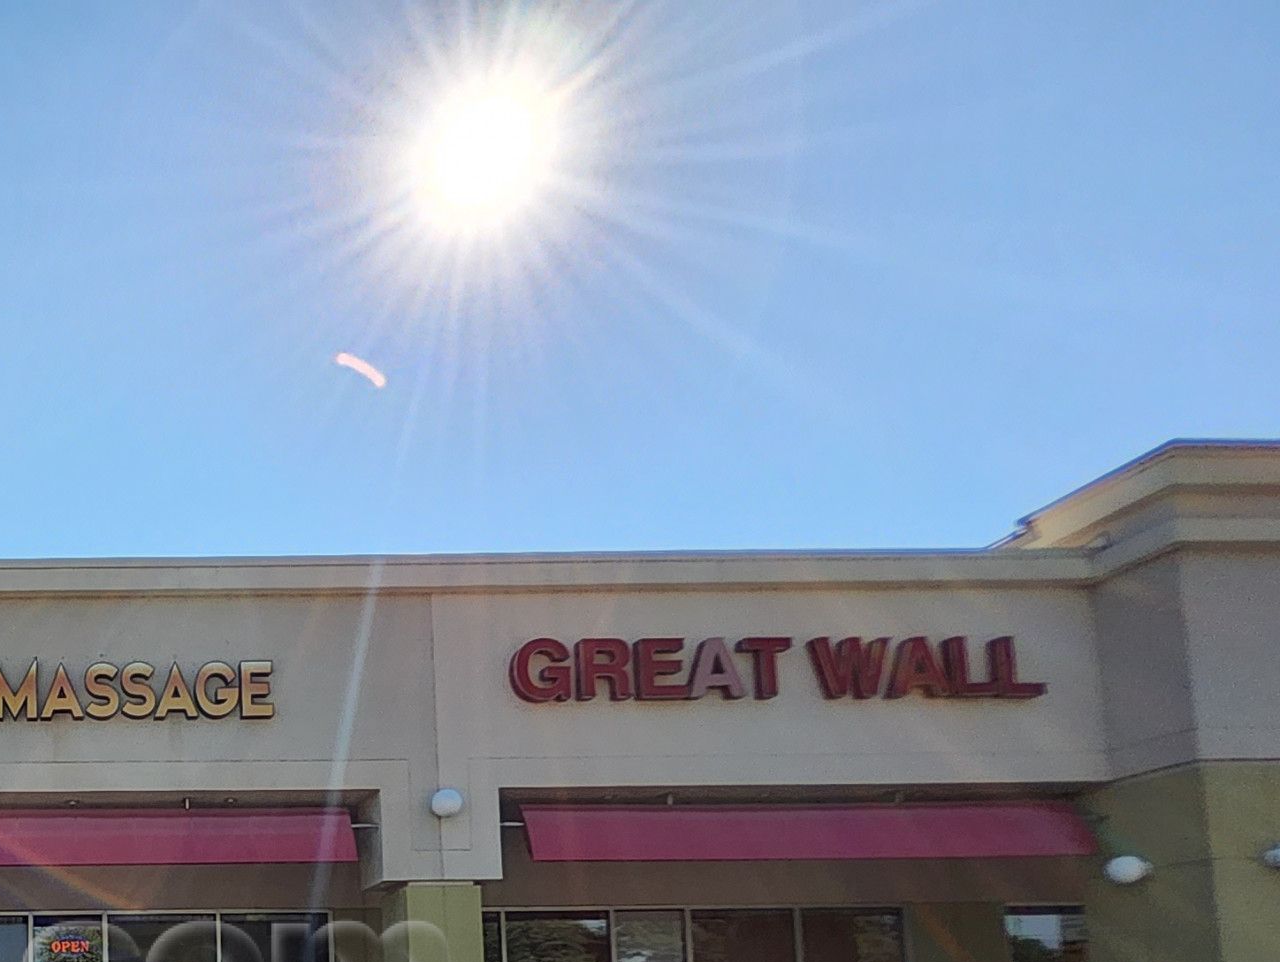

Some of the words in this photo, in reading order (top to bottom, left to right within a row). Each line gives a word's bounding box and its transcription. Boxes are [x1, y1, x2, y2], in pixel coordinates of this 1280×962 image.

[508, 636, 792, 702] GREAT
[806, 635, 1049, 701] WALL
[51, 940, 90, 953] OPEN
